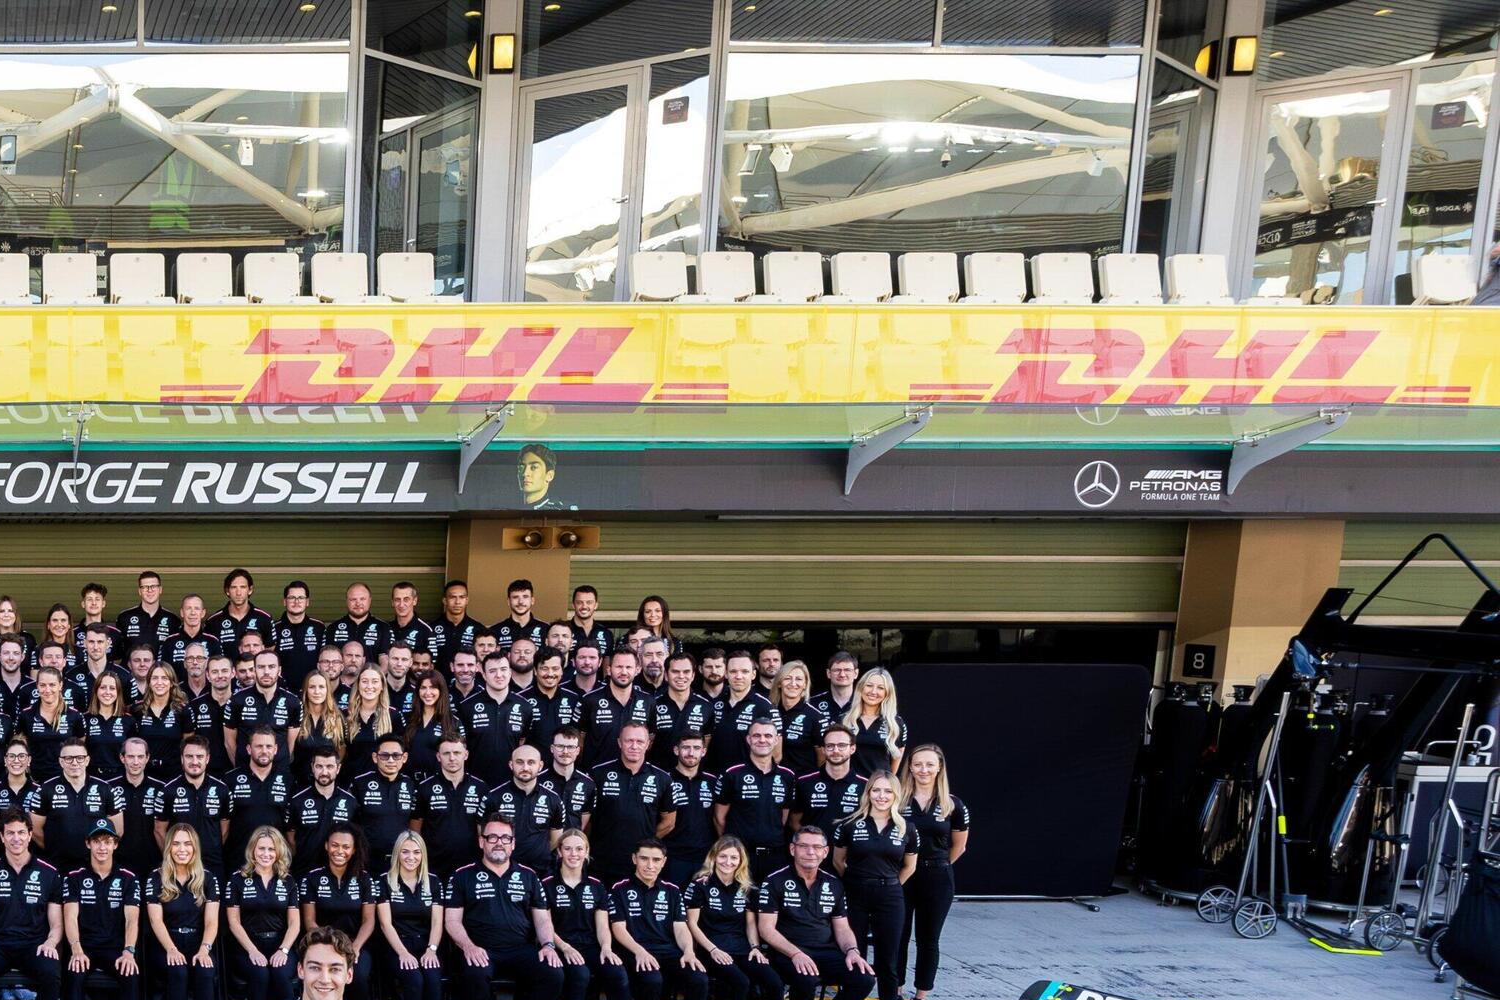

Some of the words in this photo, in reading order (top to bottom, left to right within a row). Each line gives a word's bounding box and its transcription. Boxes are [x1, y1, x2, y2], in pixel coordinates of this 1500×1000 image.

[238, 327, 653, 411] DHL
[984, 328, 1399, 411] DHL
[172, 461, 428, 504] RUSSELL
[1129, 481, 1221, 491] PETRONAS
[1170, 470, 1223, 479] AMG
[1191, 652, 1205, 670] 8
